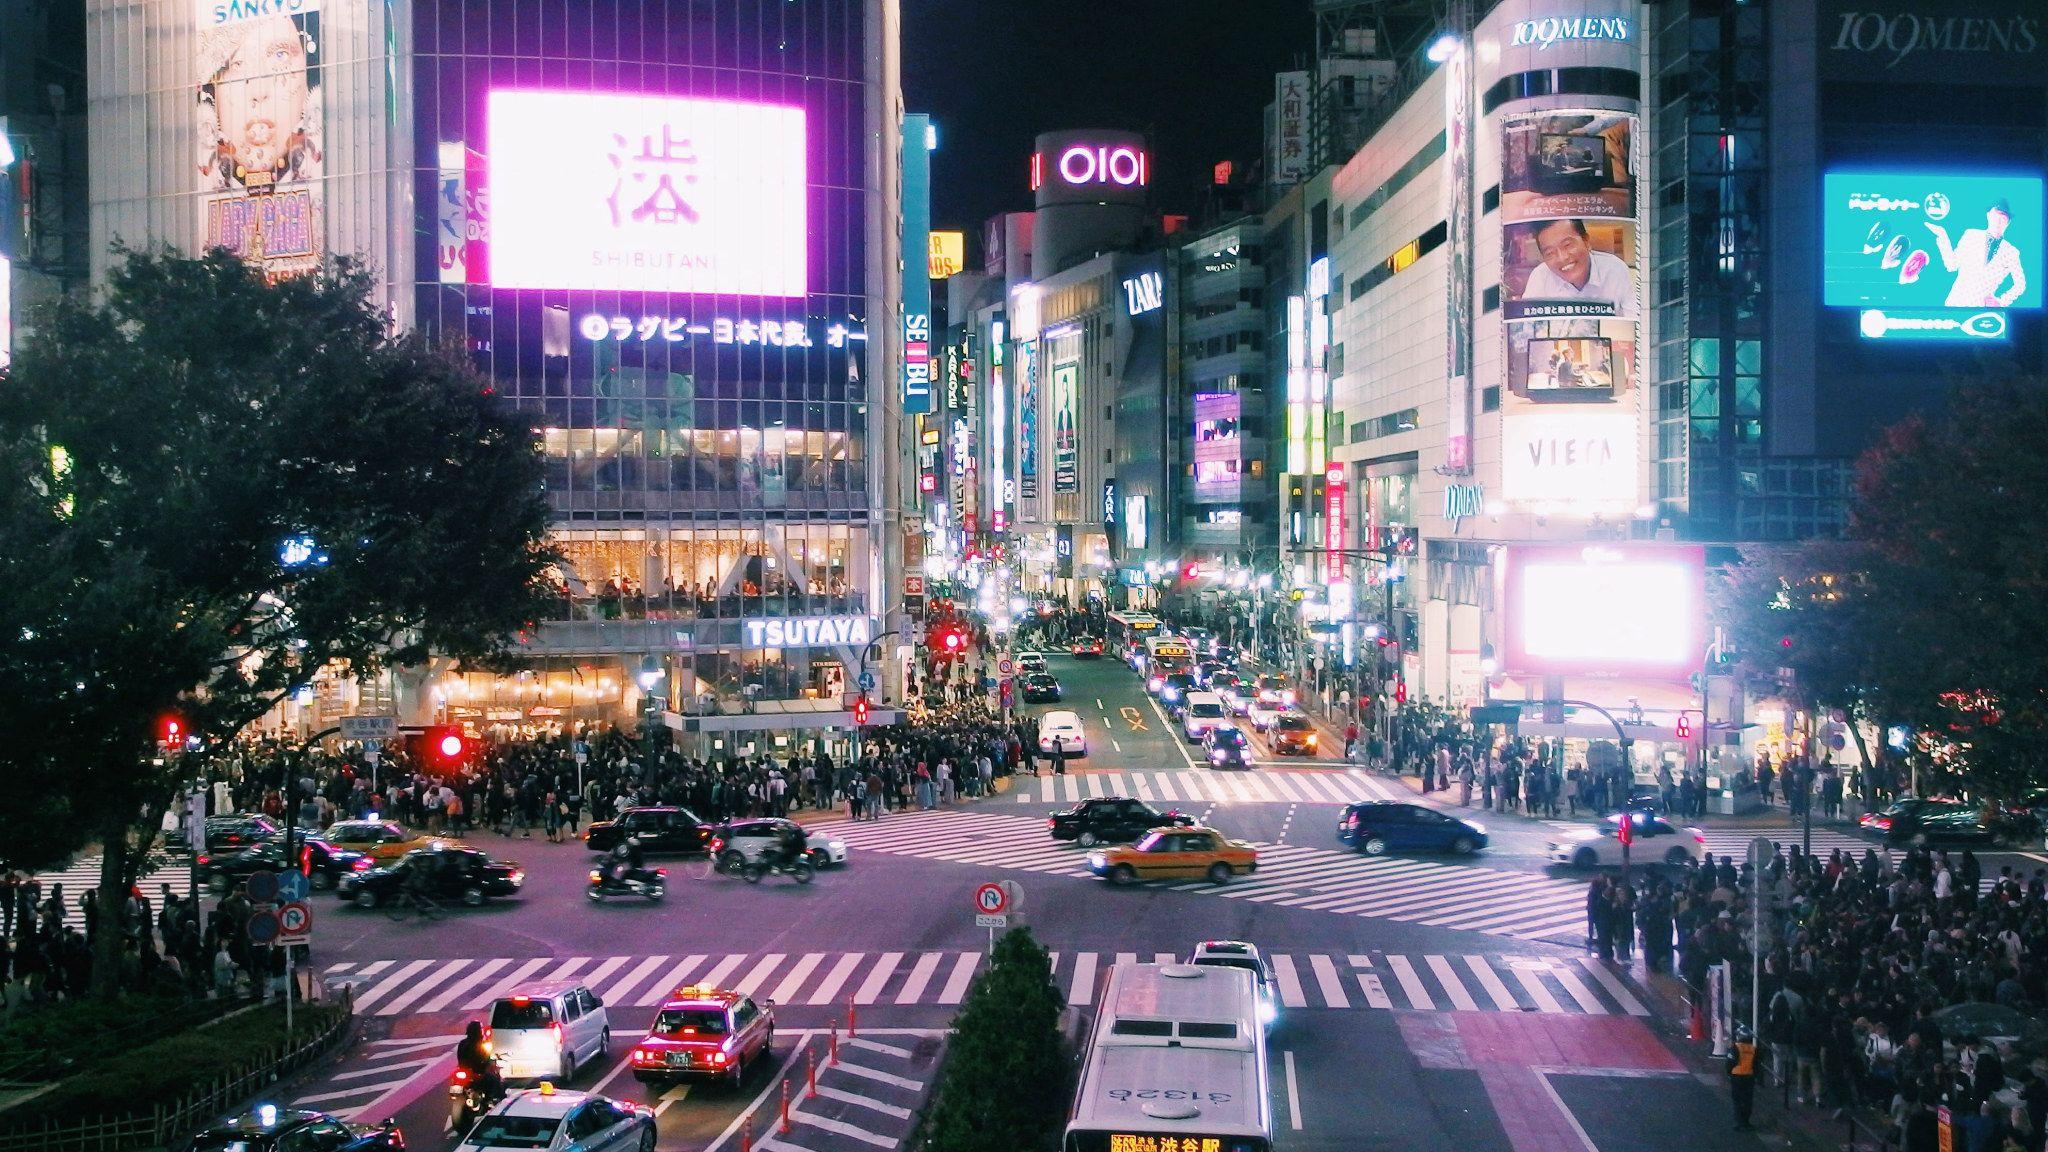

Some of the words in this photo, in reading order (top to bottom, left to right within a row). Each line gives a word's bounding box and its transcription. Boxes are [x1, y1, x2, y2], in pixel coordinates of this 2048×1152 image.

[591, 250, 717, 268] SHIBUTANI
[1123, 271, 1163, 316] ZARA
[947, 345, 958, 409] KARAOKE
[1105, 485, 1115, 523] ZARA
[747, 618, 869, 646] TSUTAYA
